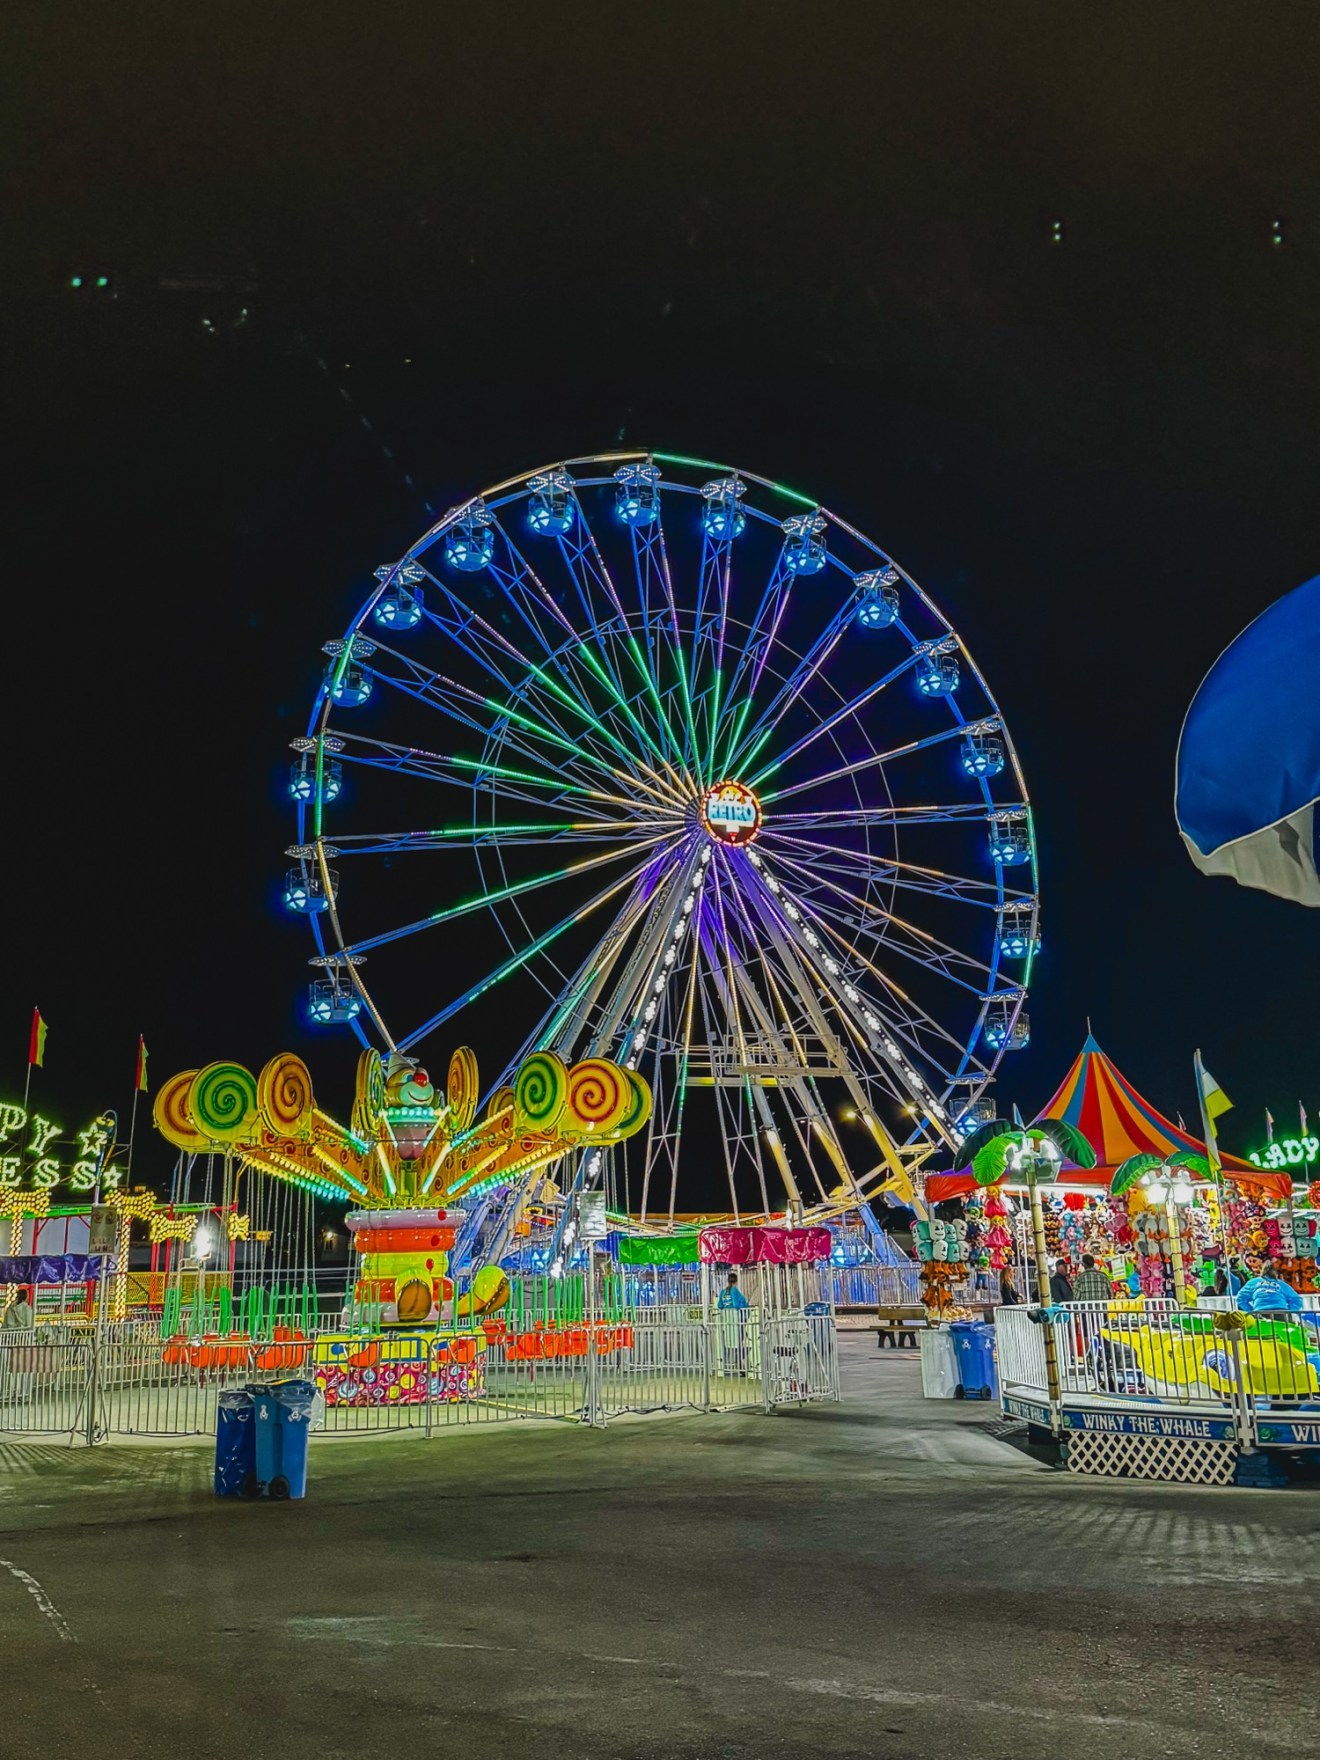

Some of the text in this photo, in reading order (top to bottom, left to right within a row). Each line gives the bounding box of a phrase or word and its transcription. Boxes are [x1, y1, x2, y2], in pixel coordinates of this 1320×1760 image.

[1082, 1413, 1212, 1437] WINKY THE WHALE
